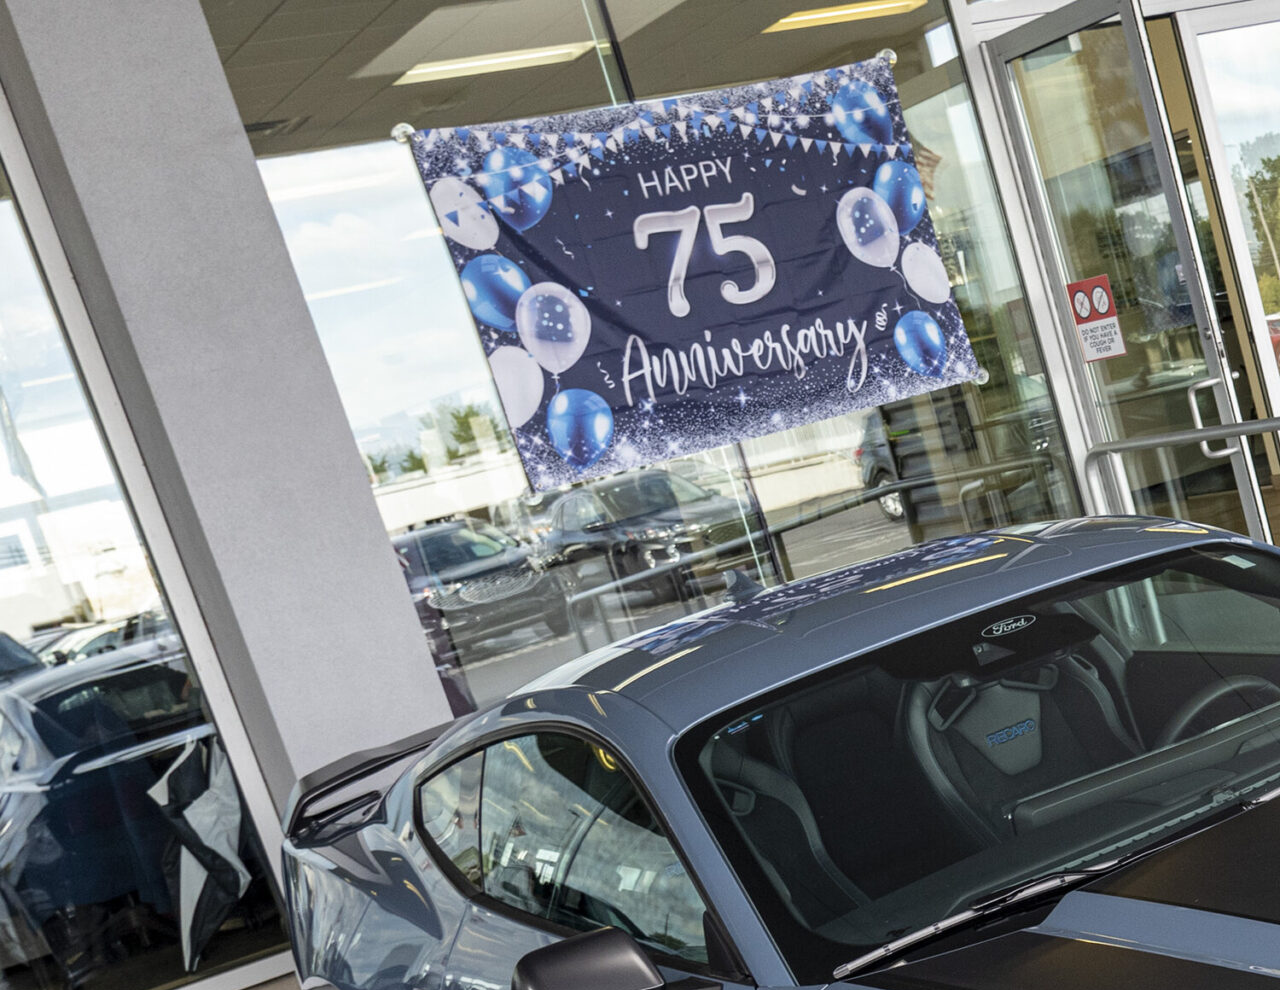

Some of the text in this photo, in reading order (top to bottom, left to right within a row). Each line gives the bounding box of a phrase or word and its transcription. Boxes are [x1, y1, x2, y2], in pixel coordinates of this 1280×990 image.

[636, 156, 734, 199] HAPPY
[632, 192, 776, 317] 75
[1081, 328, 1089, 336] DO
[1100, 323, 1116, 331] ENTER
[1090, 340, 1107, 348] COUGH
[621, 316, 868, 406] Anniversary
[992, 617, 1027, 635] Ford
[986, 719, 1036, 748] RECARO
